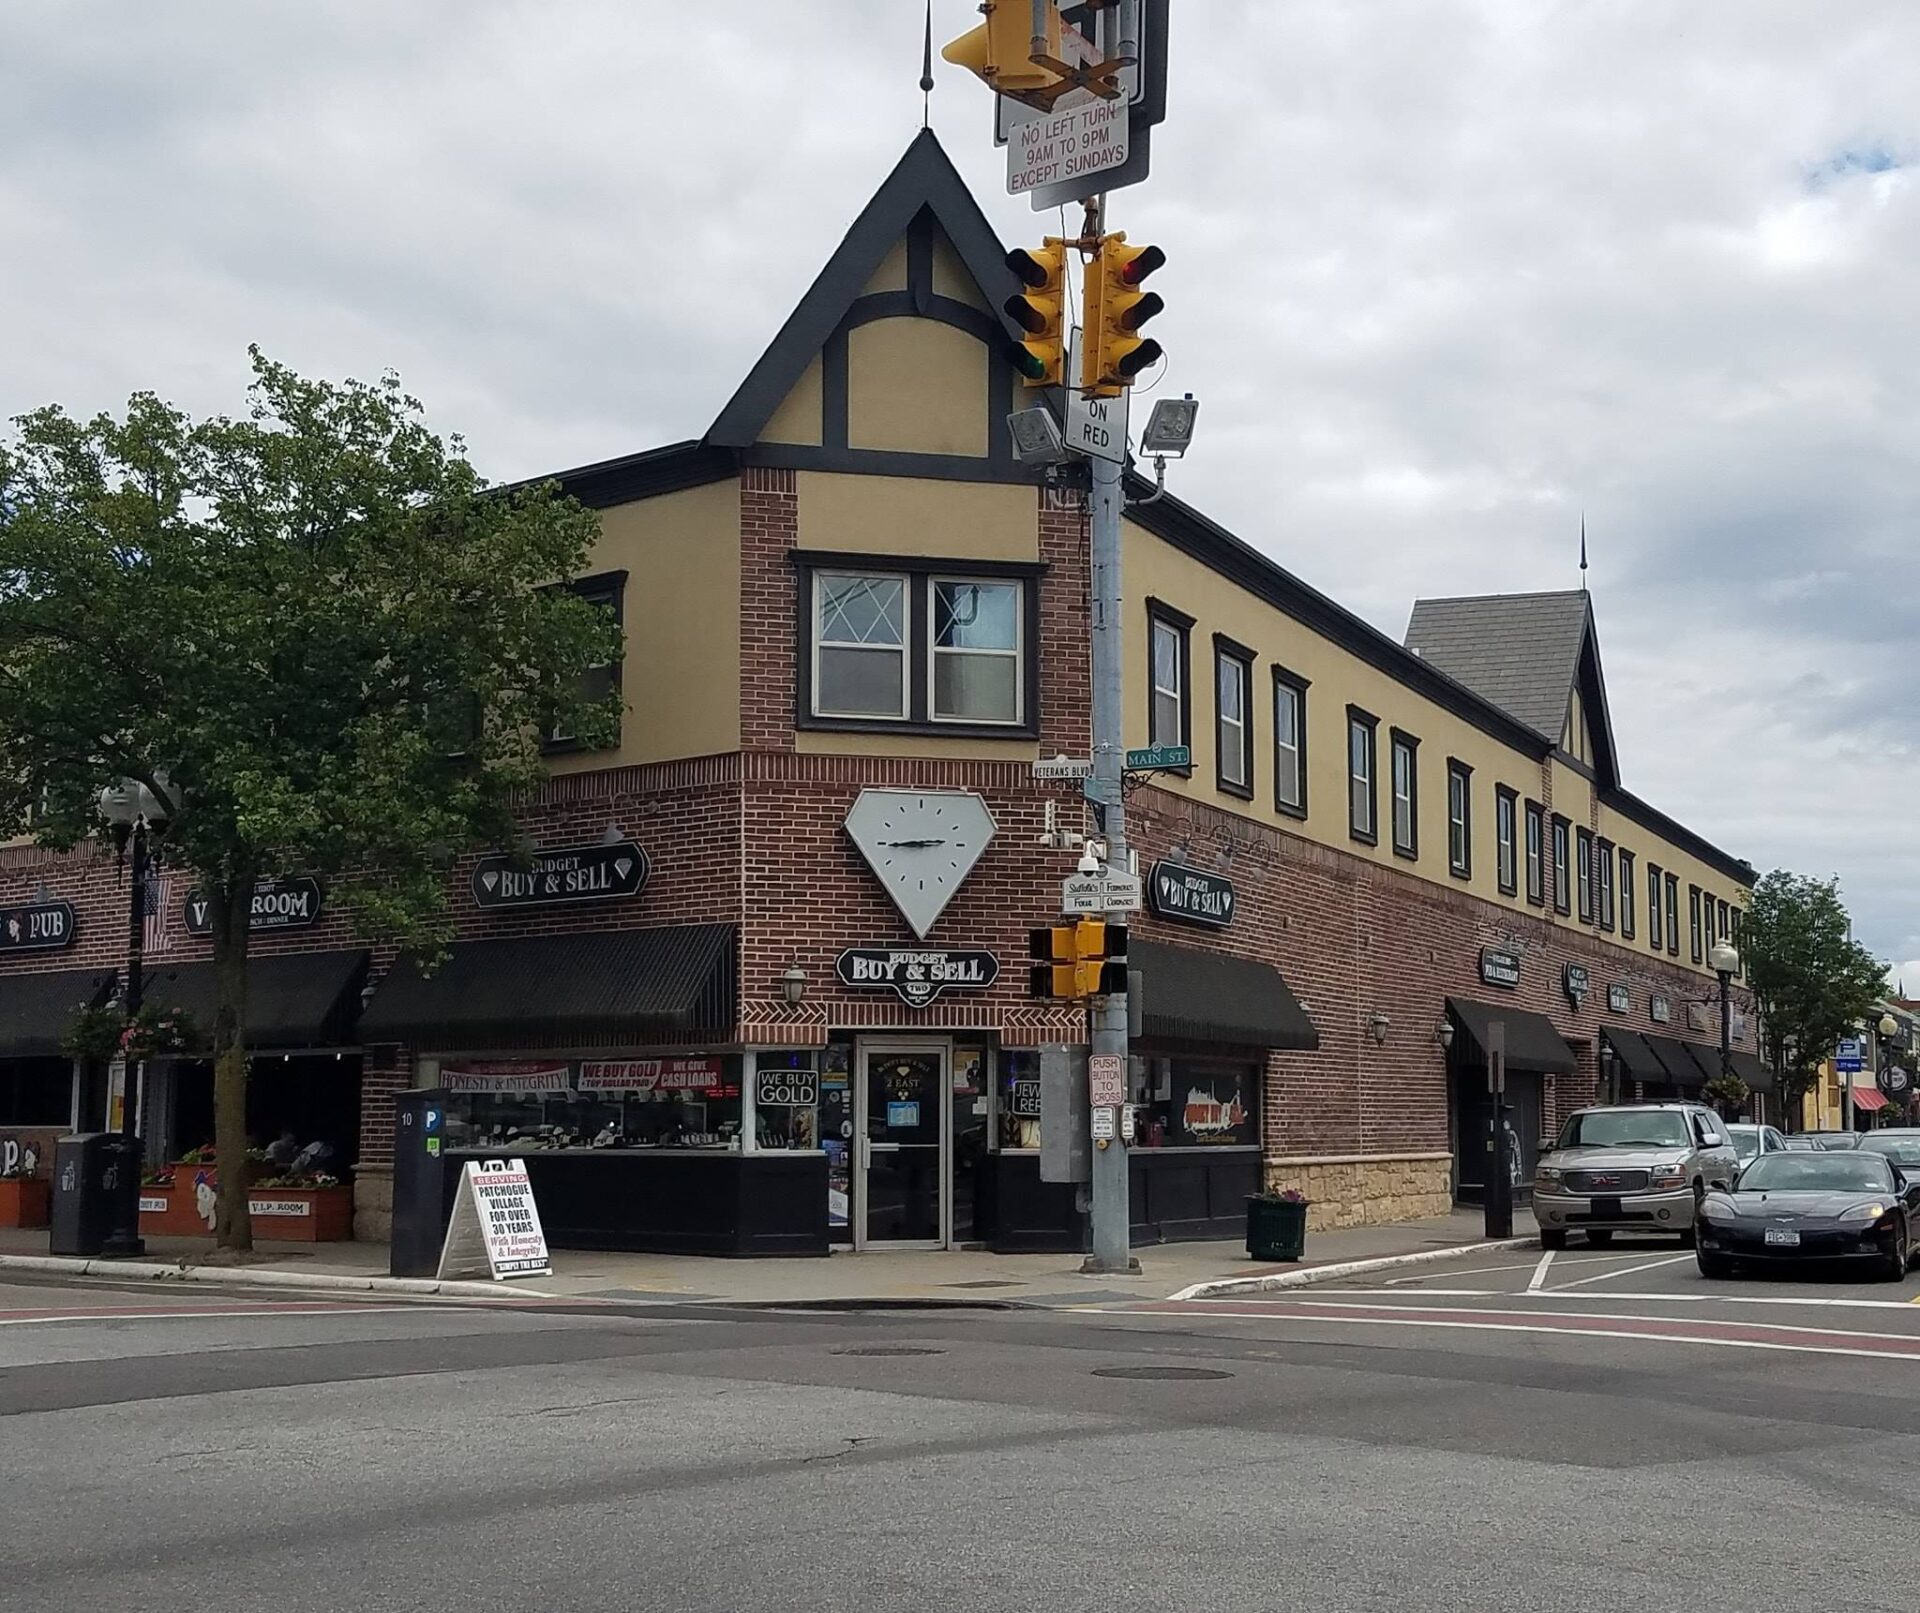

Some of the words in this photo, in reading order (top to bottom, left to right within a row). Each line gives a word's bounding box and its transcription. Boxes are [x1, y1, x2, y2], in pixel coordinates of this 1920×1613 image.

[1021, 127, 1040, 147] NO
[1045, 115, 1076, 139] LEFT
[1082, 103, 1116, 127] TURN
[1026, 144, 1053, 165] 9AM
[1060, 137, 1076, 156] TO
[1082, 127, 1110, 148] 9PM
[1011, 162, 1060, 190] EXCEPT
[1065, 144, 1124, 175] SUNDAYS
[1089, 400, 1107, 422] ON
[1083, 423, 1109, 447] RED
[1128, 754, 1161, 766] MAIN
[1169, 752, 1187, 763] ST.
[1034, 766, 1069, 777] VETERANS
[1072, 766, 1090, 777] BLVD
[501, 870, 537, 897] BUY
[545, 874, 560, 894] &
[566, 861, 612, 892] SELL
[1184, 876, 1209, 893] BUDGET
[250, 891, 309, 917] ROOM
[1170, 879, 1189, 907] BUY
[1192, 893, 1200, 911] &
[1201, 891, 1222, 915] SELL
[30, 911, 63, 938] PUB
[889, 952, 948, 965] BUDGET
[852, 956, 899, 980] BUY
[905, 964, 925, 980] &
[930, 959, 984, 981] SELL
[909, 984, 928, 992] TWO
[673, 1062, 686, 1071] WE
[1093, 1058, 1118, 1068] PUSH
[583, 1063, 601, 1078] WE
[603, 1063, 627, 1078] BUY
[628, 1063, 658, 1078] GOLD
[1092, 1071, 1119, 1080] BUTTON
[442, 1073, 489, 1090] HONESTY
[586, 1079, 601, 1088] TOP
[602, 1079, 631, 1088] DOLLAR
[661, 1073, 687, 1087] CASH
[688, 1072, 718, 1086] LOANS
[761, 1073, 782, 1085] WE
[787, 1073, 816, 1085] BUY
[895, 1079, 920, 1088] EAST
[1101, 1081, 1113, 1091] TO
[760, 1086, 814, 1103] GOLD
[1016, 1083, 1041, 1098] JEW
[1094, 1092, 1121, 1102] CROSS
[402, 1112, 412, 1126] 10
[426, 1111, 437, 1128] P
[478, 1174, 526, 1184] SERVING
[478, 1184, 530, 1198] PATCHOGUE
[277, 1203, 304, 1213] ROOM
[489, 1197, 525, 1209] VILLAGE
[489, 1211, 507, 1222] FOR
[508, 1209, 531, 1221] OVER
[492, 1223, 505, 1235] 30
[505, 1221, 534, 1234] YEARS
[490, 1236, 509, 1246] With
[511, 1235, 542, 1246] Honesty
[498, 1247, 506, 1257] &
[507, 1246, 541, 1257] Integrity
